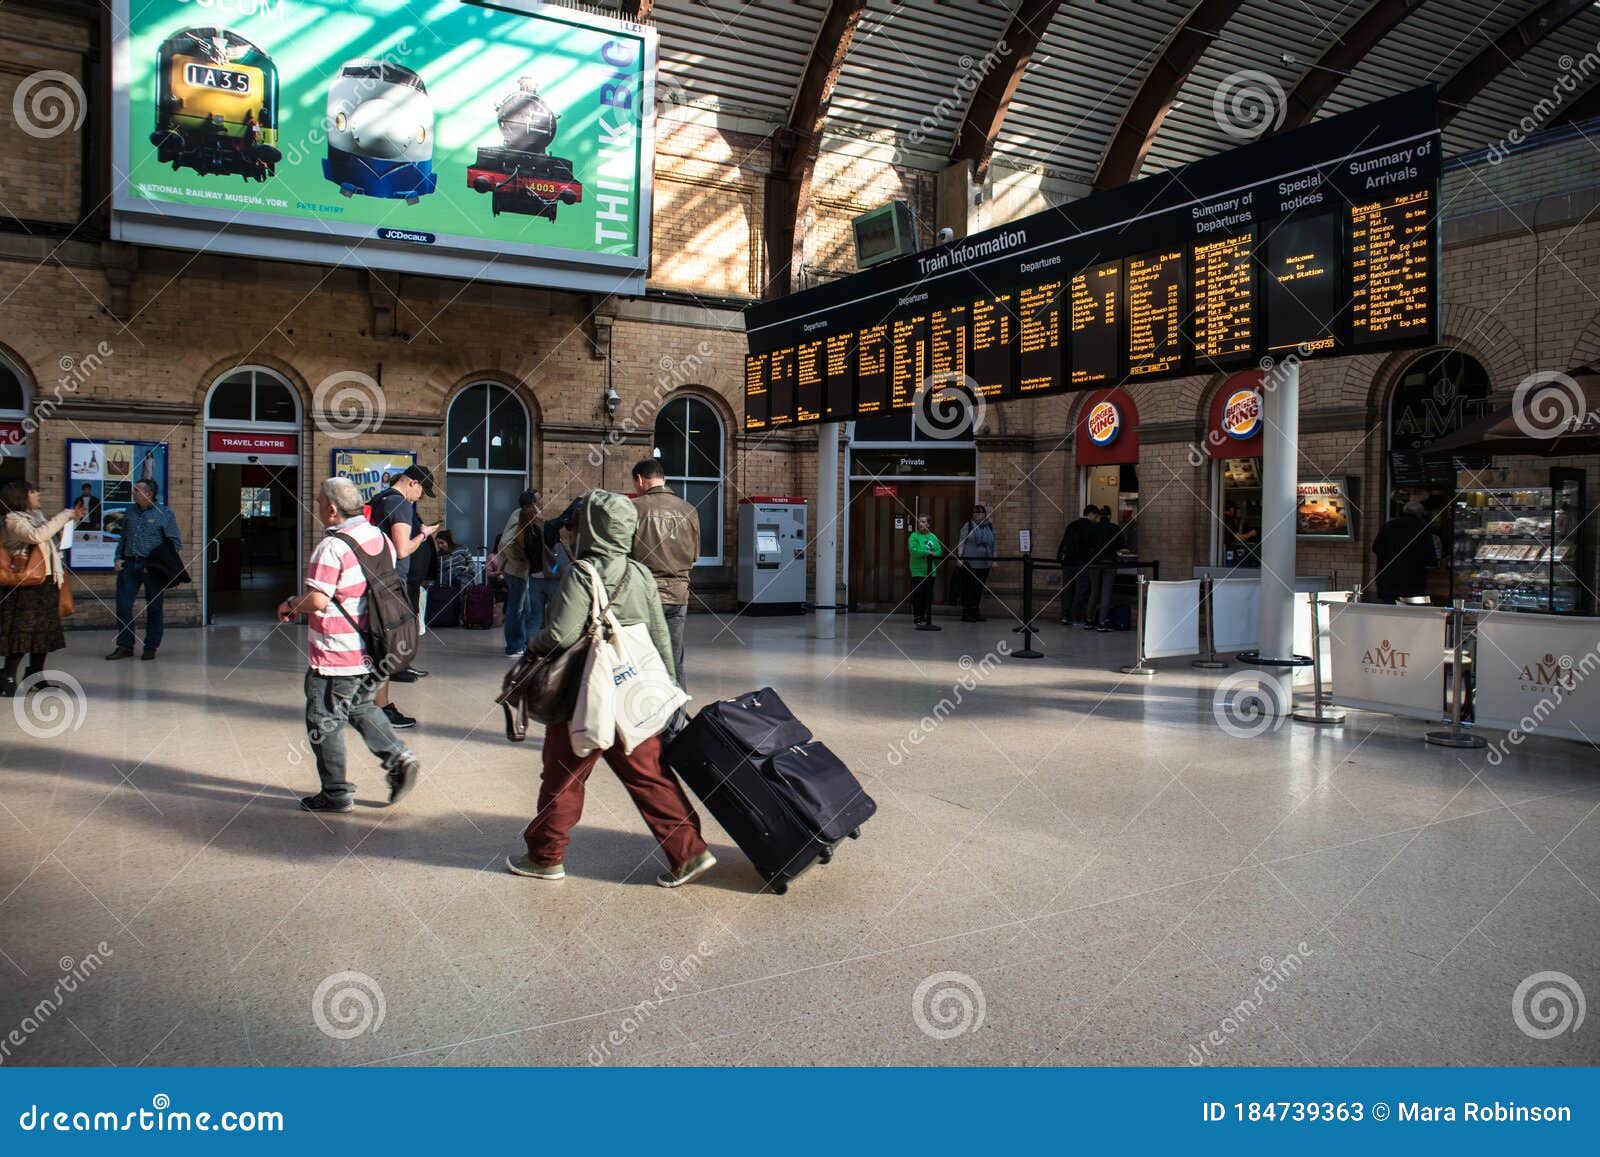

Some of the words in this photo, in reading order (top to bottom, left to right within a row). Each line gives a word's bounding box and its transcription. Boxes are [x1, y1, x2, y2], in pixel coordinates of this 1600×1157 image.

[600, 40, 633, 110] BIG
[1350, 149, 1413, 175] Summary
[1417, 141, 1431, 155] of
[530, 182, 555, 193] 4003
[596, 117, 632, 246] THINK
[1278, 173, 1322, 196] Special
[1366, 166, 1418, 190] Arrivals
[139, 184, 182, 195] NATIONAL
[185, 189, 223, 200] RAILWAY
[225, 193, 264, 206] MUSEUM,
[266, 197, 288, 208] YORK
[1192, 198, 1239, 220] Summary
[1241, 192, 1253, 205] of
[1280, 191, 1324, 212] notices
[319, 203, 345, 213] ENTRY
[1352, 202, 1380, 215] Arrivals
[1196, 211, 1252, 233] Departures
[1370, 219, 1381, 227] Plat
[385, 230, 428, 243] JCDecaux
[918, 252, 949, 274] Train
[950, 229, 1027, 265] Information
[1195, 241, 1225, 254] Departures
[1020, 254, 1062, 273] Departures
[1286, 254, 1315, 264] Welcome
[1278, 273, 1295, 282] York
[1296, 268, 1324, 279] Station
[898, 291, 929, 306] Departures
[1370, 283, 1404, 294] Scarborough
[803, 320, 828, 332] Departures
[1370, 316, 1392, 324] Glasgow
[1090, 406, 1113, 428] BURGER
[1226, 396, 1257, 419] BURGER
[1226, 404, 1258, 430] KING
[1091, 413, 1115, 438] KING
[222, 438, 252, 447] TRAVEL
[254, 439, 285, 448] CENTRE
[1319, 485, 1338, 495] KING
[1362, 648, 1410, 669] AMT
[1518, 663, 1580, 687] AMT
